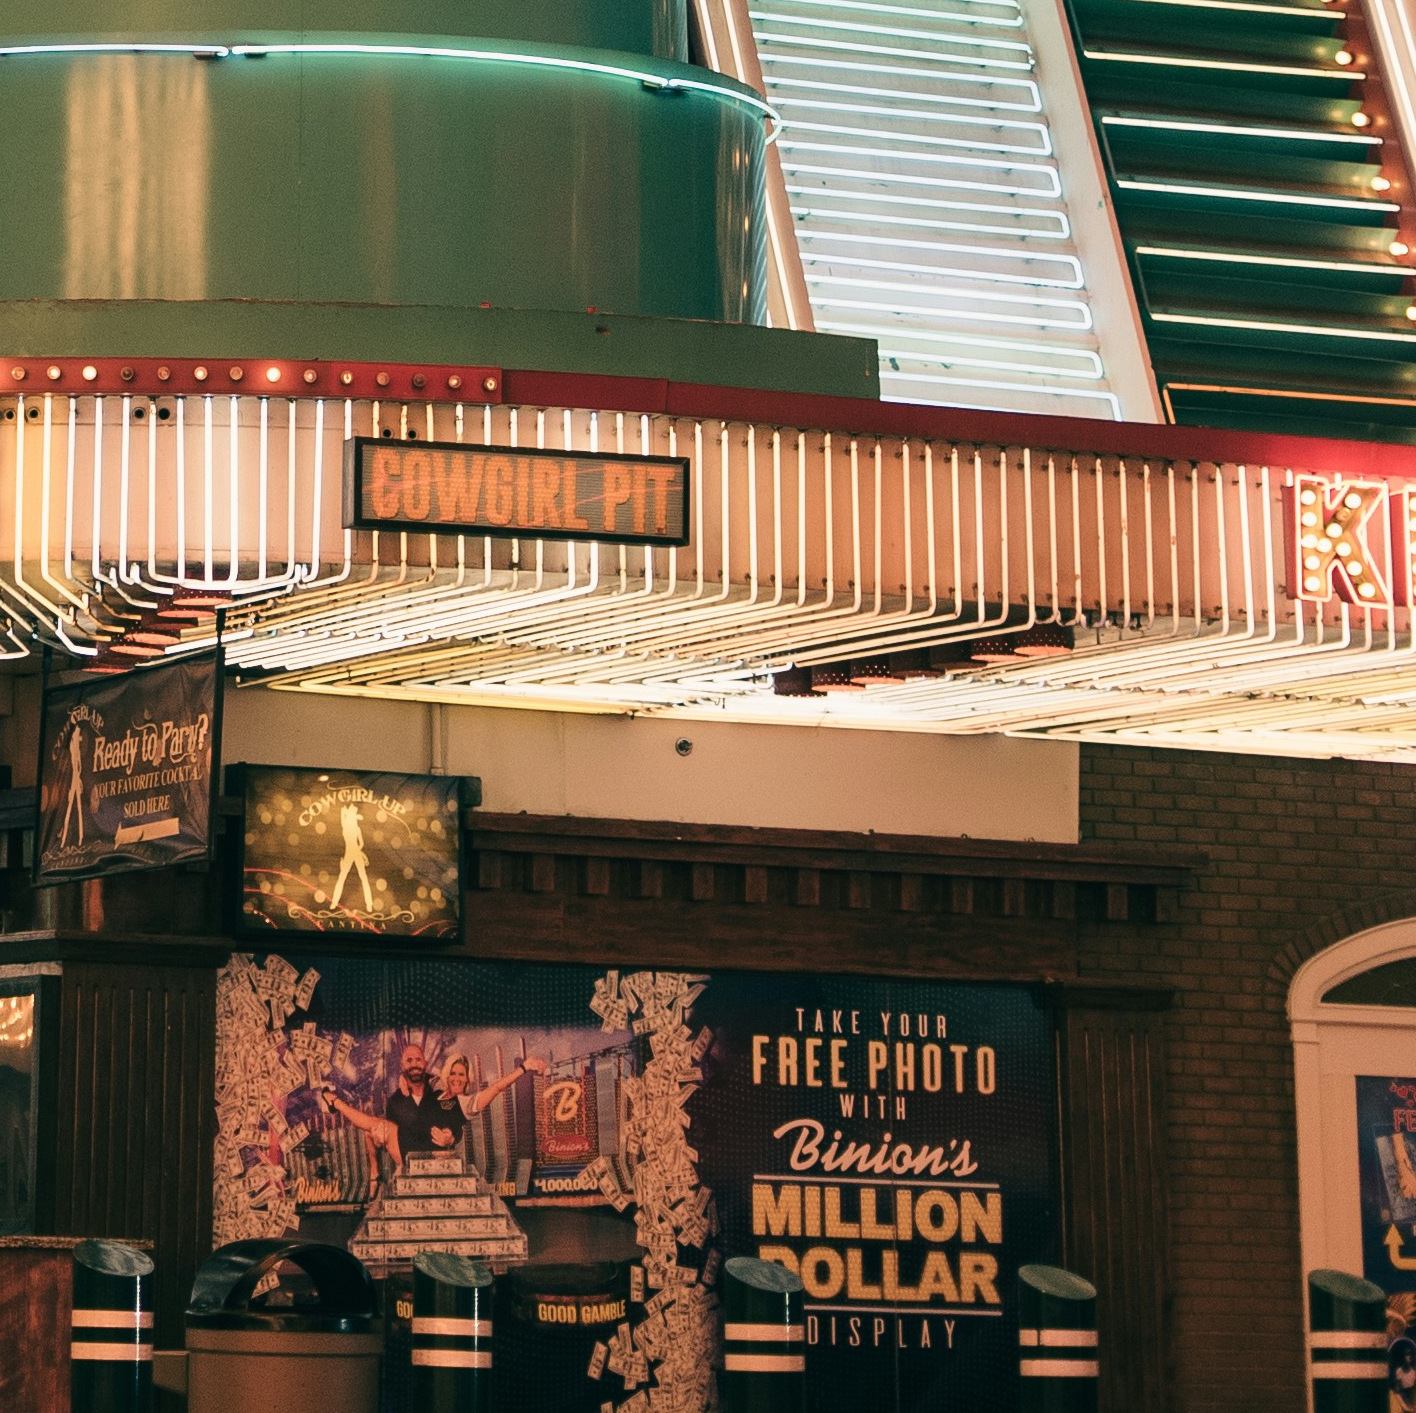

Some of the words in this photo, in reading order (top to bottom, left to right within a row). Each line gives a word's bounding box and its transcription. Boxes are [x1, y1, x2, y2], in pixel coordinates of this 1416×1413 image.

[371, 448, 589, 530] COWGIRL
[602, 463, 675, 534] PIT
[93, 729, 139, 774] Ready
[141, 728, 159, 763] to
[93, 781, 117, 800] YOUR
[117, 772, 159, 796] FAVORITE
[123, 799, 146, 819] SOLD
[147, 794, 171, 815] HERE
[298, 787, 378, 827] COWGIRL
[378, 795, 406, 817] UP
[316, 920, 387, 931] CANTINA
[795, 1007, 861, 1034] TAKE
[880, 1012, 948, 1039] YOUR
[752, 1034, 849, 1088] FREE
[867, 1040, 996, 1095] PHOTO
[838, 1093, 907, 1120] WITH
[773, 1118, 979, 1178] Binion's
[752, 1183, 1002, 1244] MILLION
[537, 1303, 578, 1324] GOOD
[581, 1299, 627, 1325] GAMBLE
[807, 1315, 955, 1348] DISPLAY
